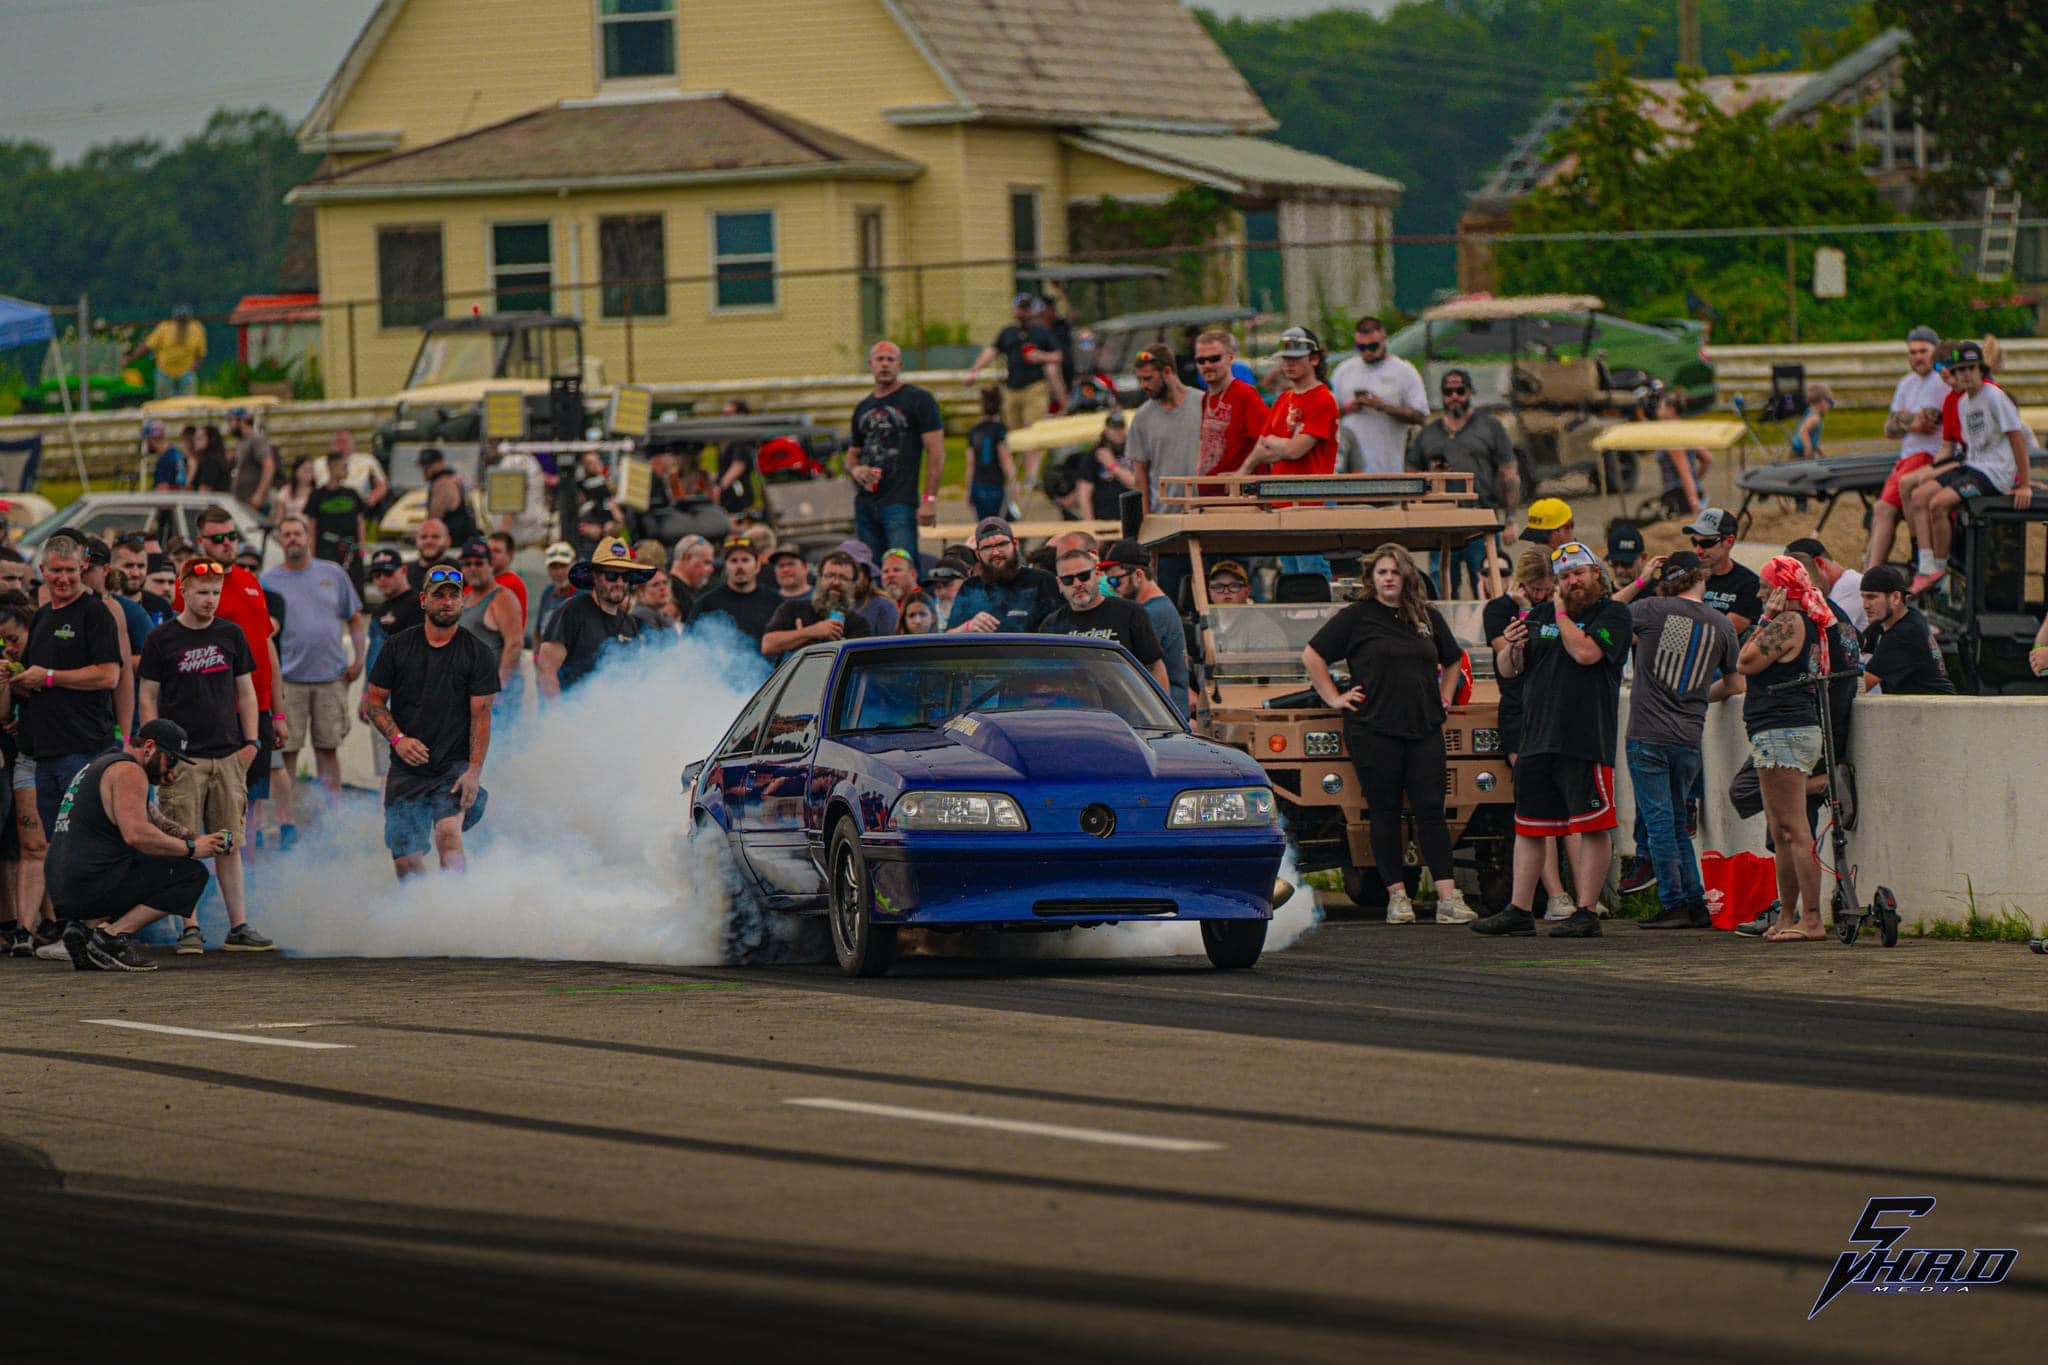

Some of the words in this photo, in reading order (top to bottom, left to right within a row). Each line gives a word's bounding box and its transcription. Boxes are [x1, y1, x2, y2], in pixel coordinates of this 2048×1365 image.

[1703, 591, 1737, 602] BLER
[184, 645, 219, 661] STEVE
[178, 655, 225, 672] RHYMER
